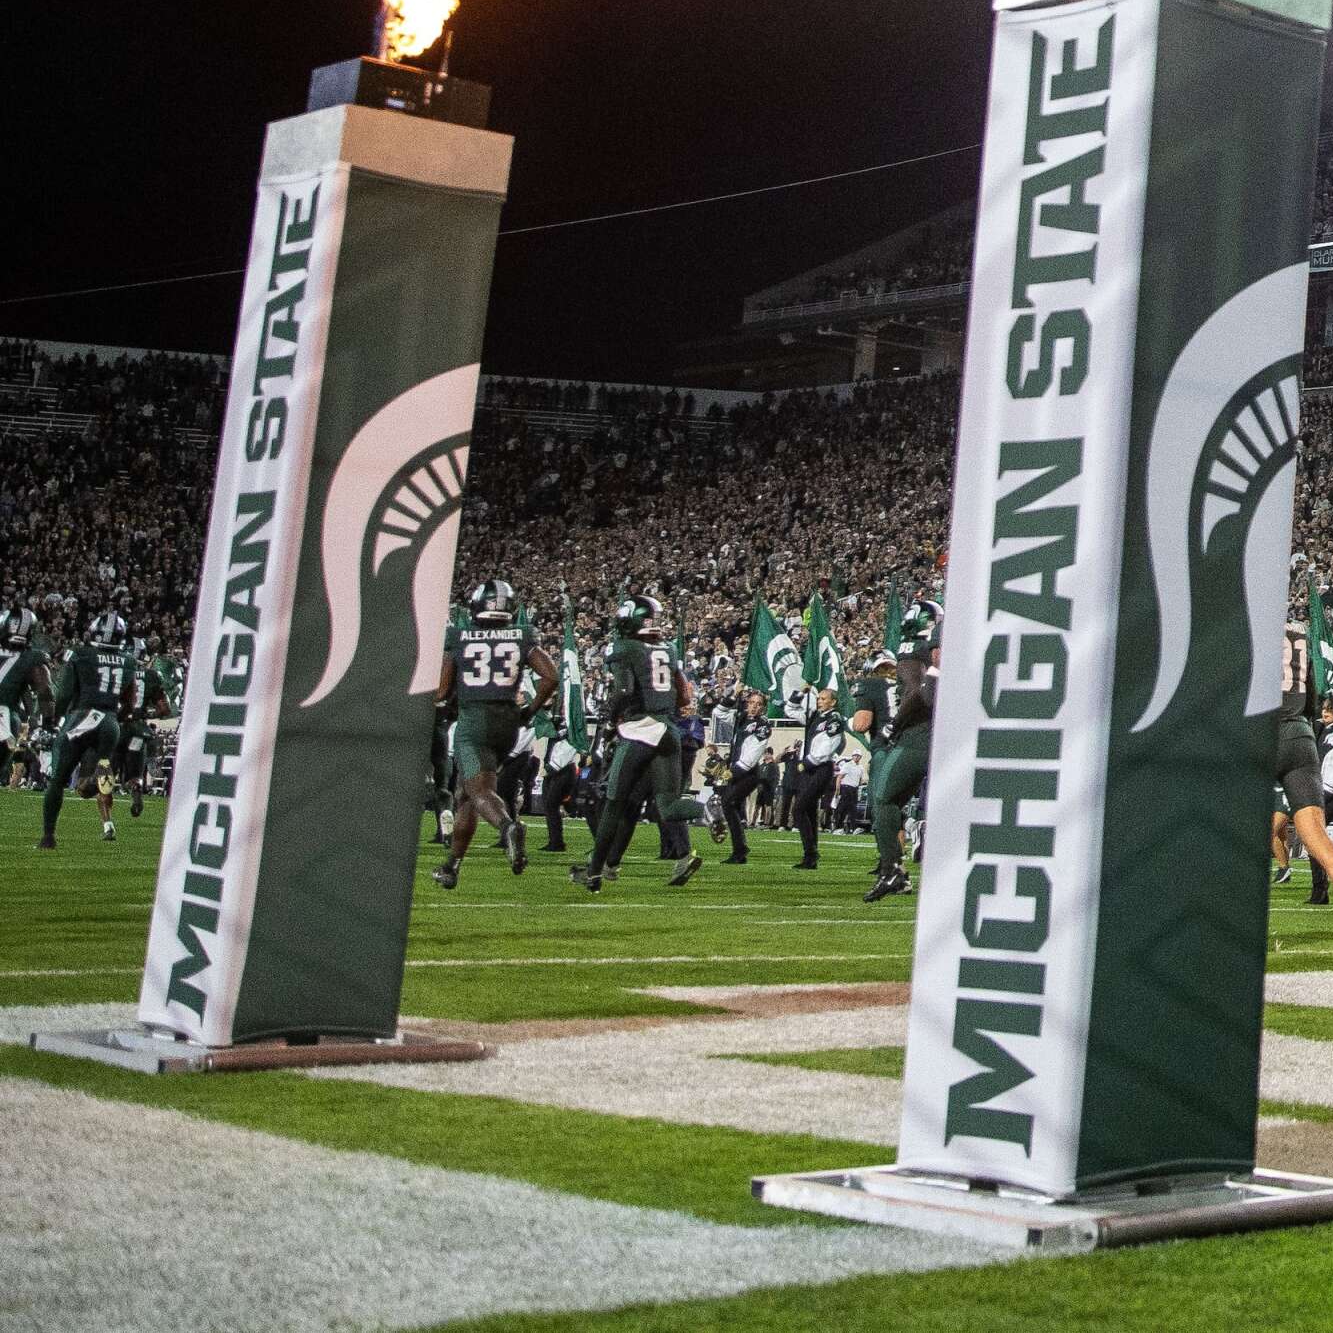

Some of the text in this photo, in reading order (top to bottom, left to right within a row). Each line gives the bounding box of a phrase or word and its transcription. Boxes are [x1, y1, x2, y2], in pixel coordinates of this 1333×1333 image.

[165, 182, 321, 1028] MICHIGAN STATE
[945, 14, 1115, 1158] MICHIGAN STATE
[461, 629, 523, 642] ALEXANDER
[97, 654, 126, 666] TALLEY
[463, 643, 521, 687] 33
[650, 650, 671, 692] 6
[98, 667, 123, 696] 11
